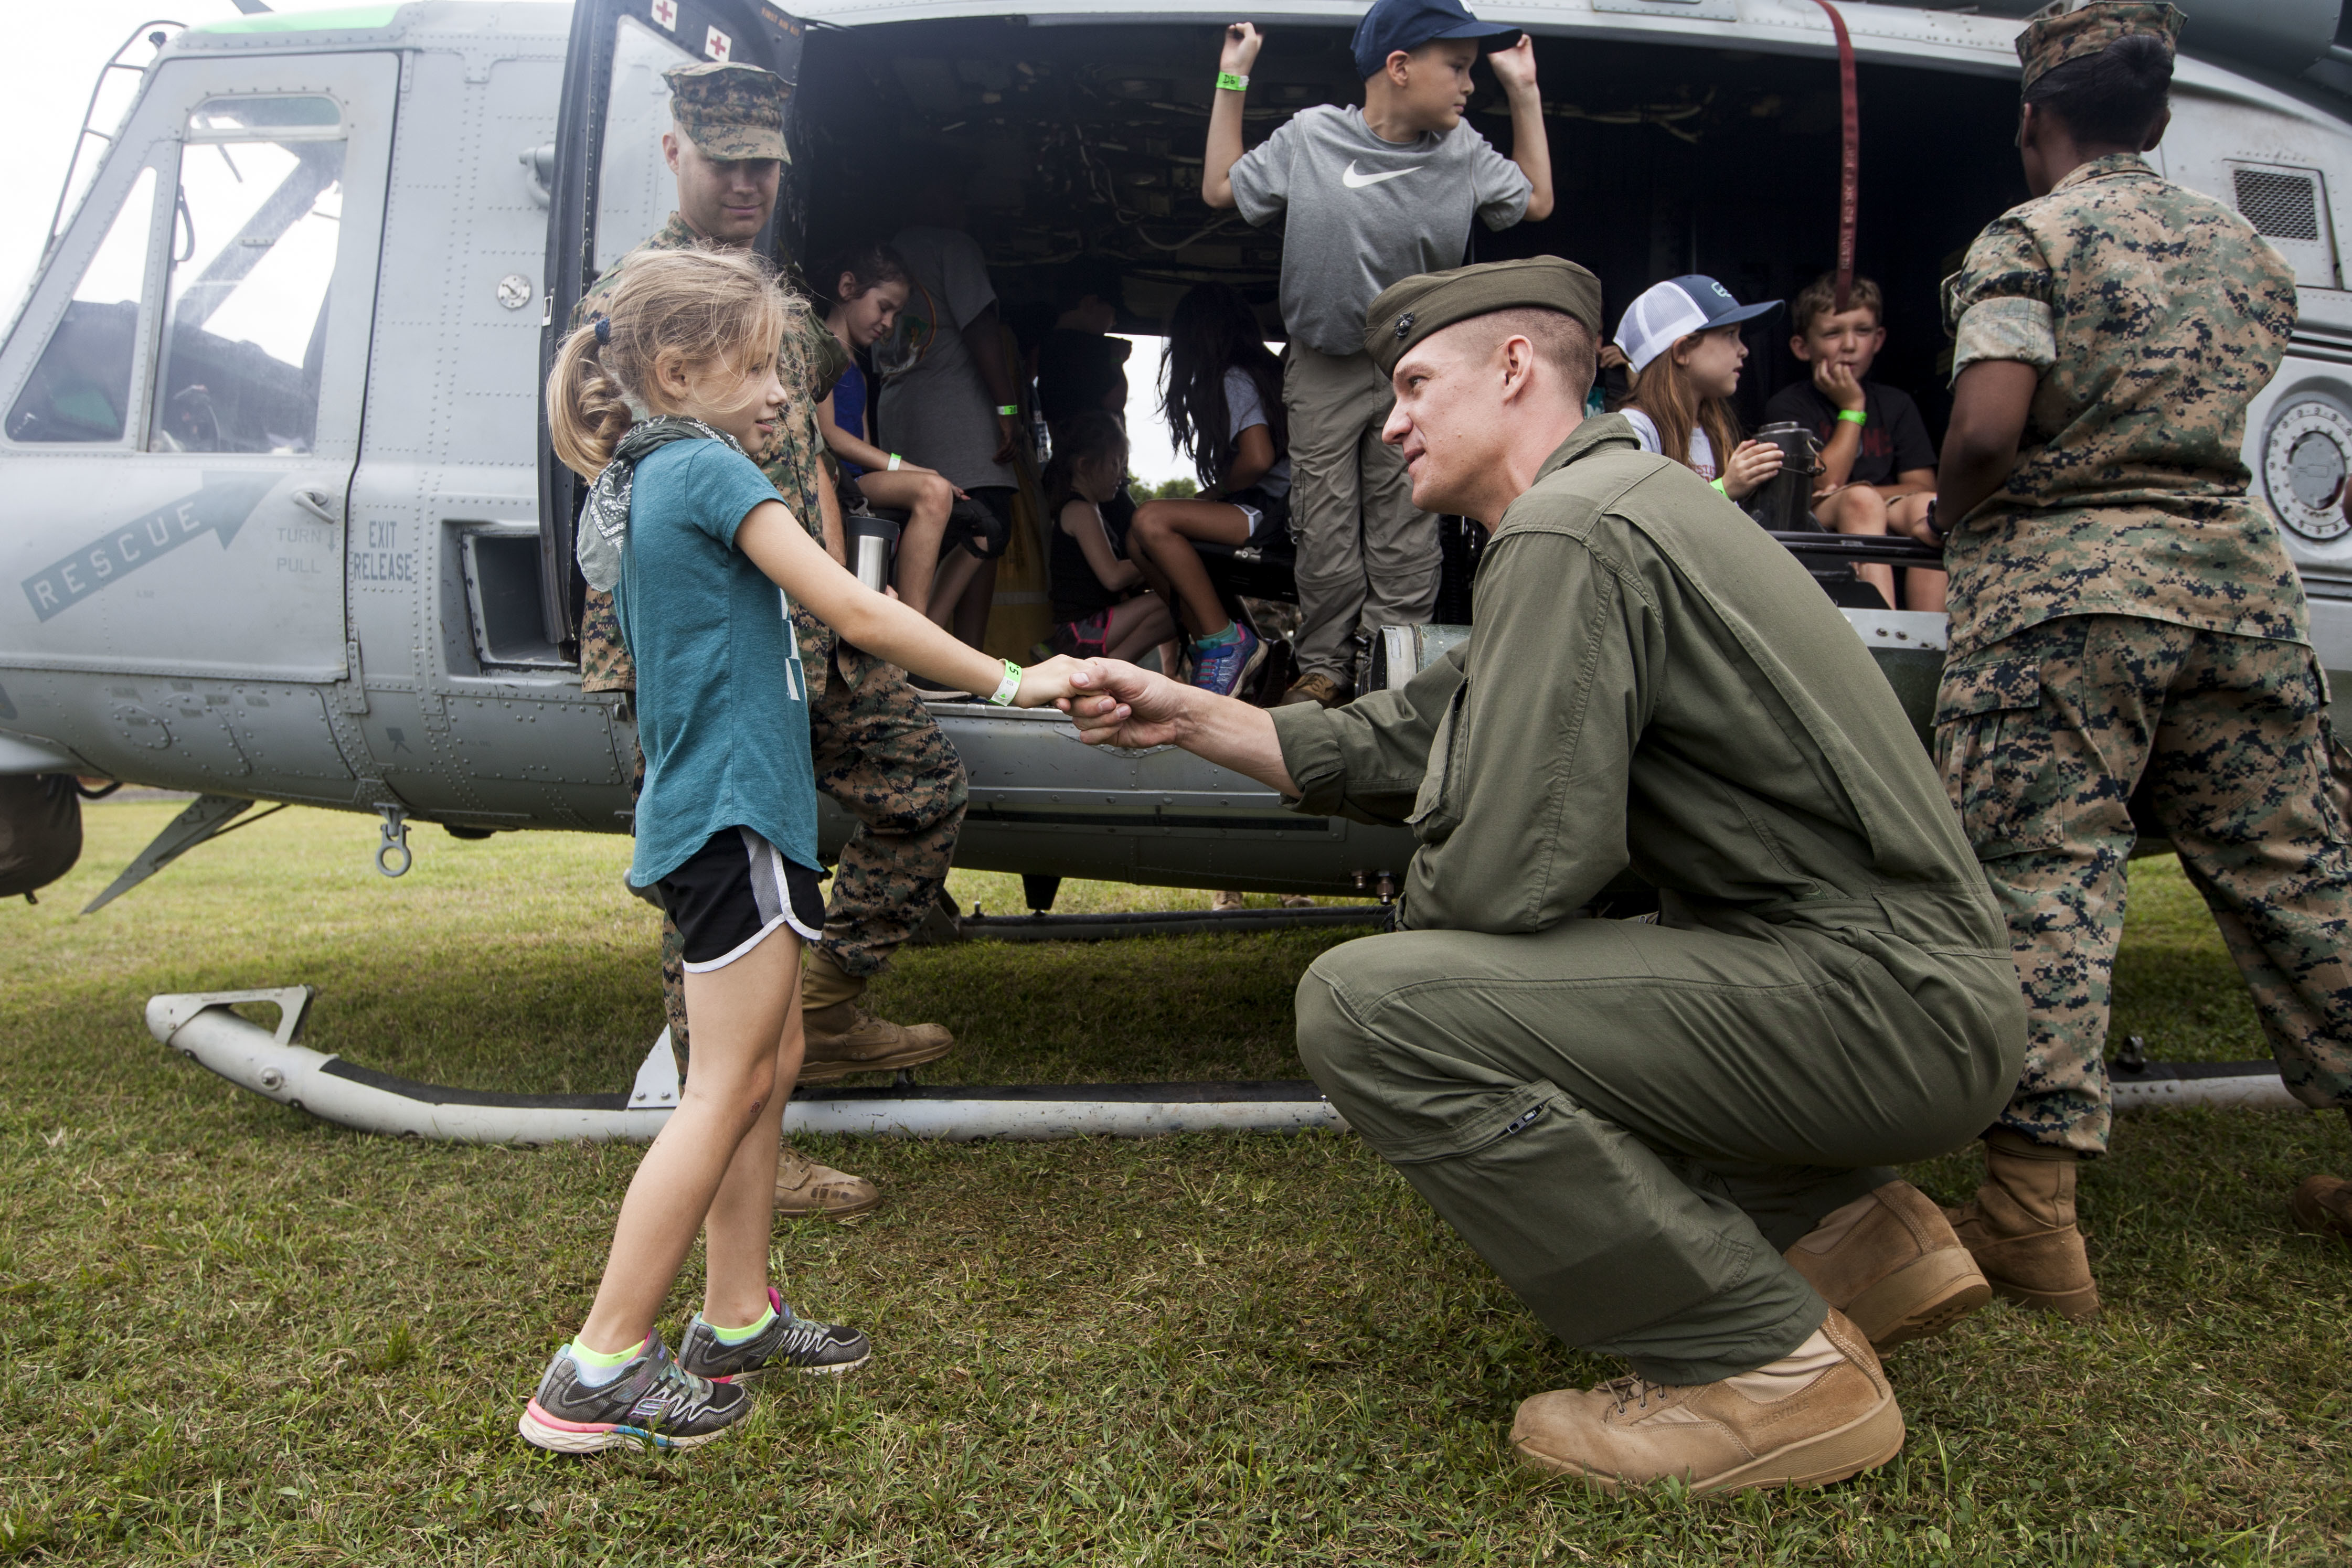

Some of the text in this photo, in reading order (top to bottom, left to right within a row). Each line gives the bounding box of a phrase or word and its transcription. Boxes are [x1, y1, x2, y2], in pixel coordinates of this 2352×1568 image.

[276, 528, 322, 542] TURN
[369, 521, 397, 549] EXIT
[34, 502, 200, 610] RESCUE
[277, 558, 322, 573] PULL
[354, 553, 412, 581] RELEASE
